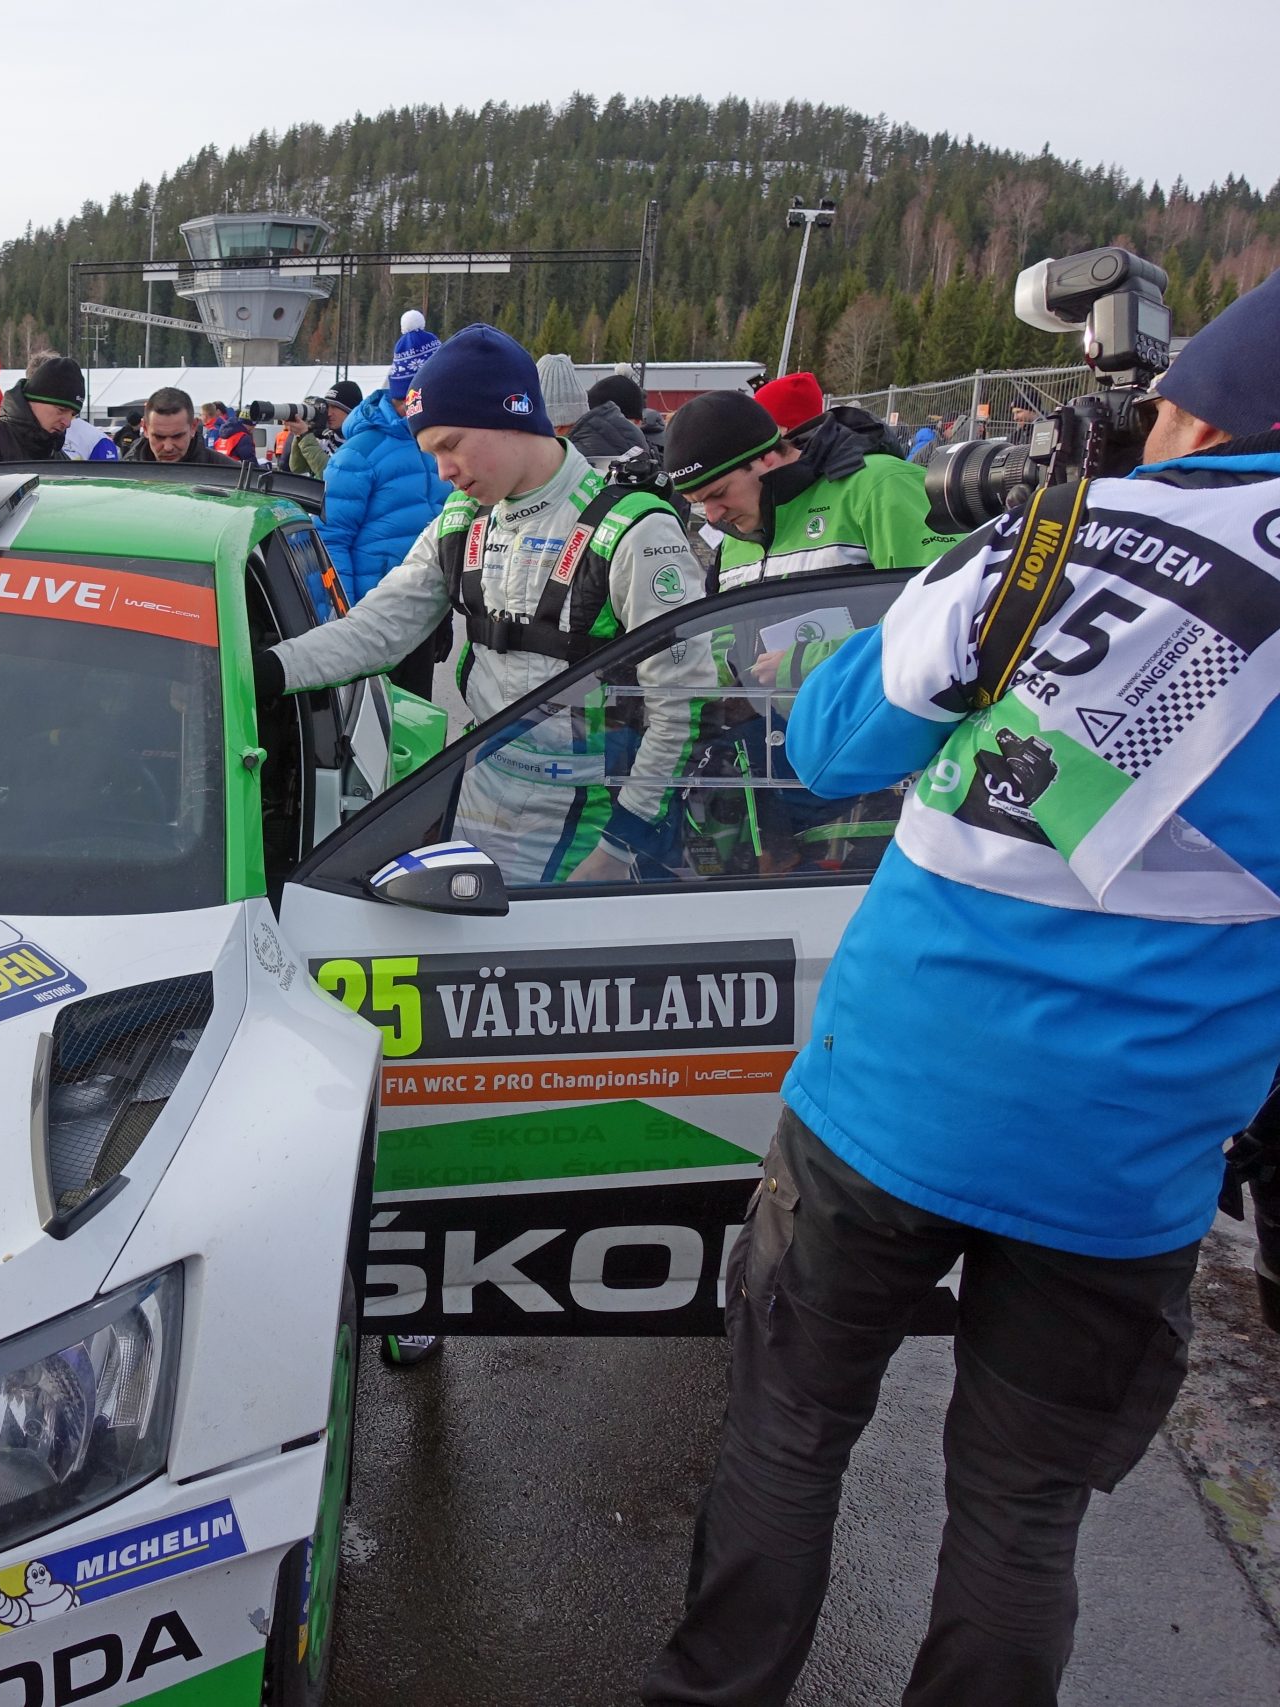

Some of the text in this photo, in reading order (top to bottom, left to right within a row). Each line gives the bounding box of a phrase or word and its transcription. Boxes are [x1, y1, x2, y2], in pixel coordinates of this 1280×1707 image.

[511, 395, 529, 413] IKH
[505, 500, 551, 523] ŠKODA
[808, 505, 830, 514] ŠKODA
[468, 523, 482, 565] SIMPSON
[643, 545, 689, 557] ŠKODA
[921, 535, 957, 546] ŠKODA
[558, 531, 585, 578] SIMPSON
[1016, 518, 1063, 592] Nikon
[1116, 618, 1193, 698] WARNING MOTORSPORT CAN BE
[1124, 624, 1206, 708] DANGEROUS
[490, 752, 541, 773] Rovanperä
[33, 983, 76, 1003] HISTORIC
[316, 957, 779, 1058] 25 VÄRMLAND
[385, 1076, 420, 1095] FIA
[423, 1074, 468, 1093] WRC
[473, 1073, 486, 1091] 2
[493, 1071, 534, 1091] PRO
[540, 1068, 681, 1091] Championship
[471, 1124, 607, 1148] ŠKODA
[363, 1211, 744, 1317] ŠKO
[75, 1513, 235, 1582] MICHELIN
